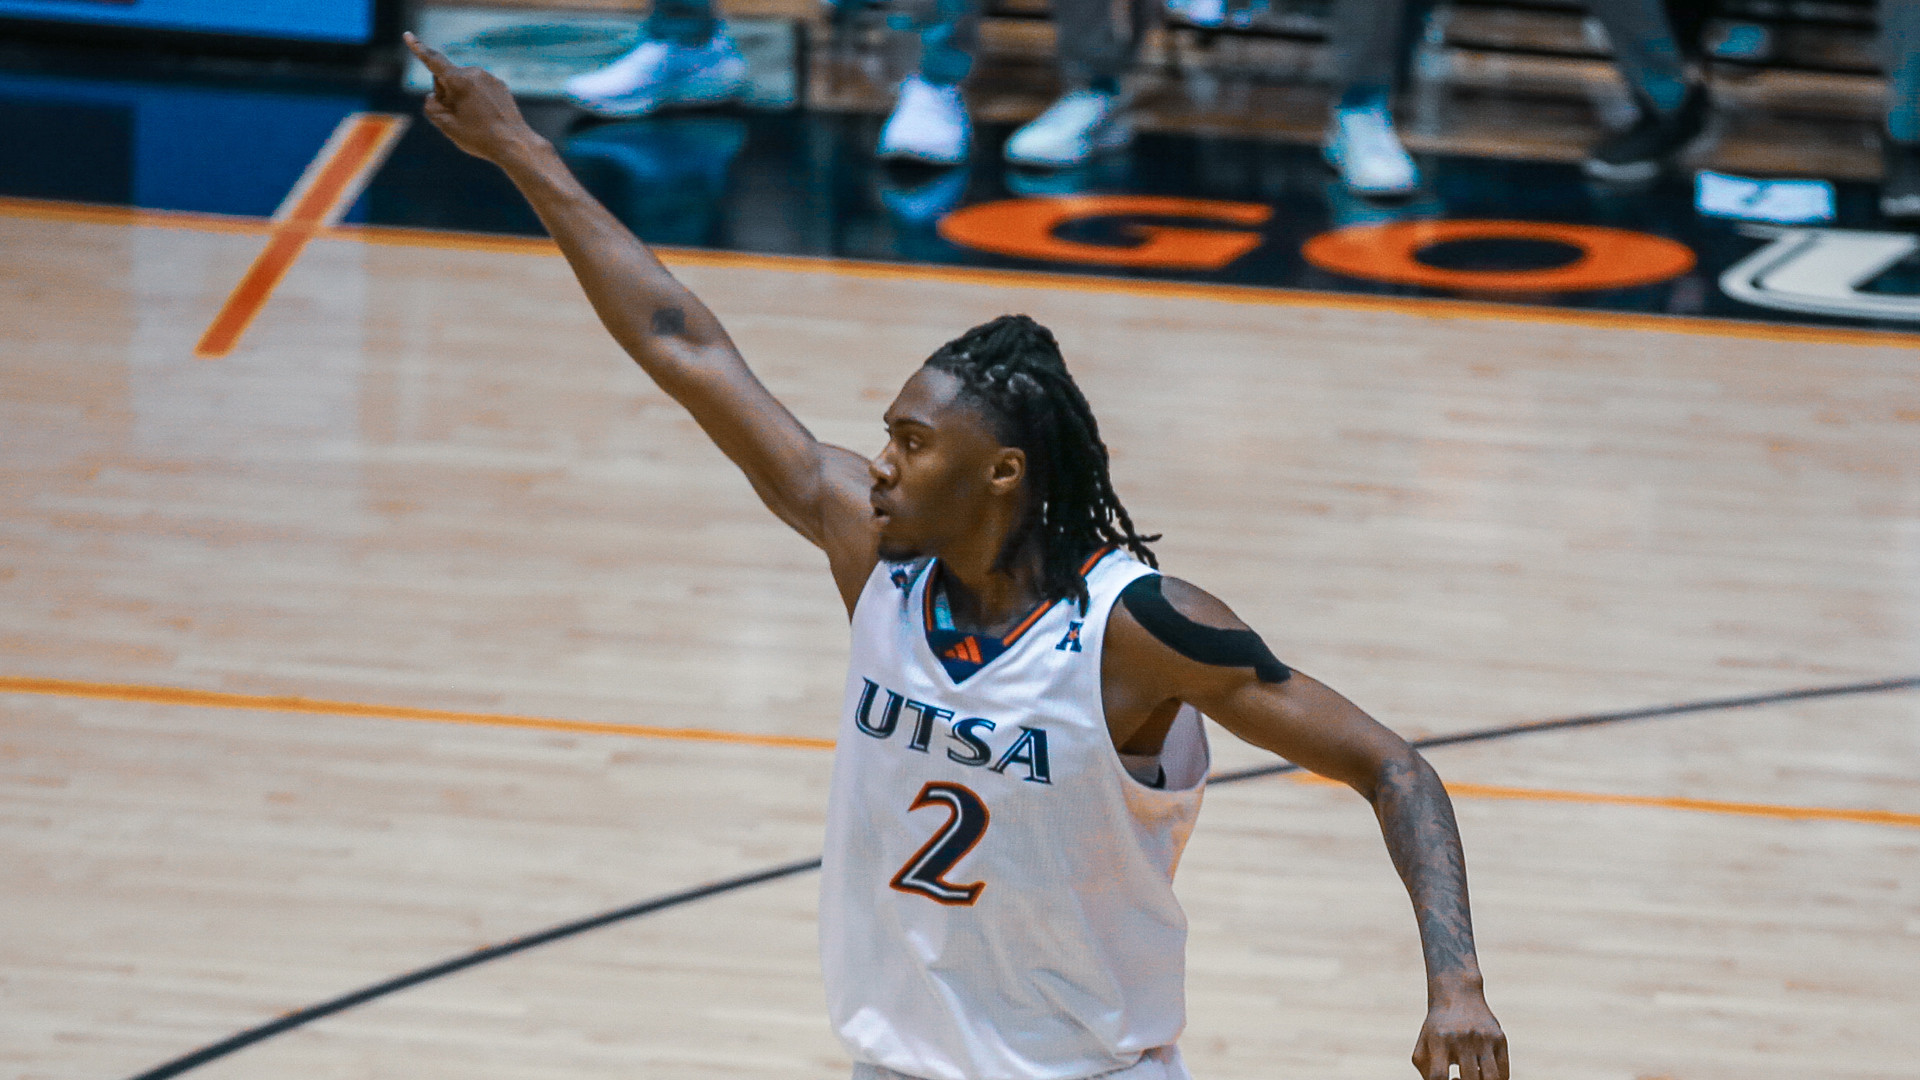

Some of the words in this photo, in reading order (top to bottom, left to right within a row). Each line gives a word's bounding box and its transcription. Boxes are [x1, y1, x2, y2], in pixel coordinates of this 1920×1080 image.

[937, 195, 1697, 293] GO
[854, 677, 1053, 785] UTSA
[889, 780, 991, 907] 2
